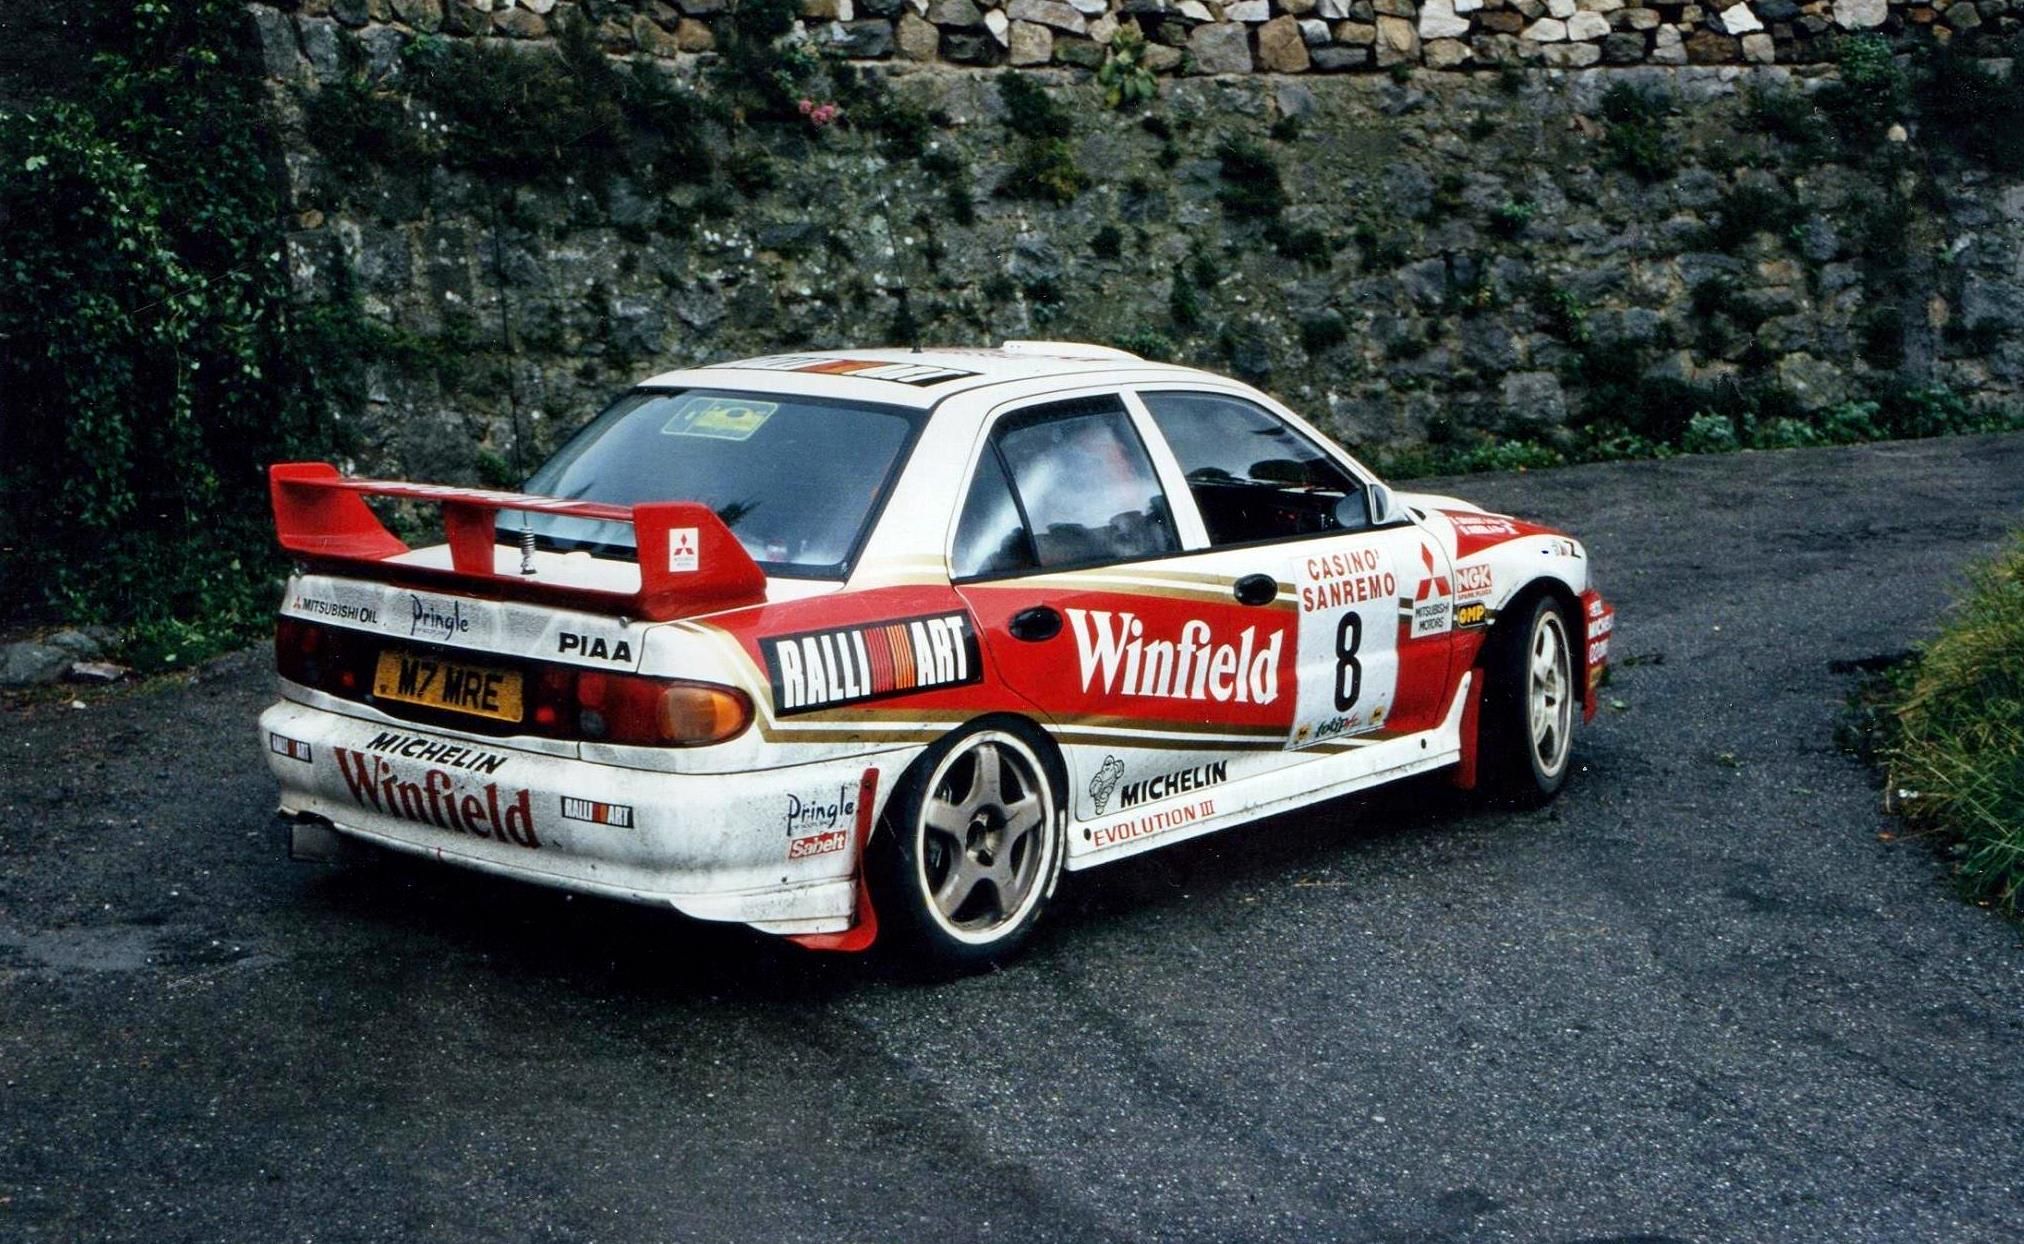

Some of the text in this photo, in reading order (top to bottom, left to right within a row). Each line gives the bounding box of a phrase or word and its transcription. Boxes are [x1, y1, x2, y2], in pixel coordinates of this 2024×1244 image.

[1303, 572, 1396, 612] SANREMO
[1456, 565, 1491, 592] NGK
[302, 598, 378, 624] MITSUBISHI OIL
[410, 593, 469, 641] Pringle
[1415, 602, 1450, 618] MITSUBISHI
[1419, 616, 1445, 631] MOTORS
[1460, 605, 1485, 624] OMP
[559, 632, 632, 662] PIAA
[1065, 608, 1284, 705] Winfield
[1334, 611, 1362, 712] 8
[397, 657, 504, 712] M7 MRE
[366, 731, 508, 775] MICHELIN
[334, 745, 542, 849] Winfield
[1120, 760, 1228, 808] MICHELIN
[786, 785, 855, 837] Pringle
[1093, 800, 1216, 847] EVOLUTION III
[790, 833, 846, 858] Sabelt
